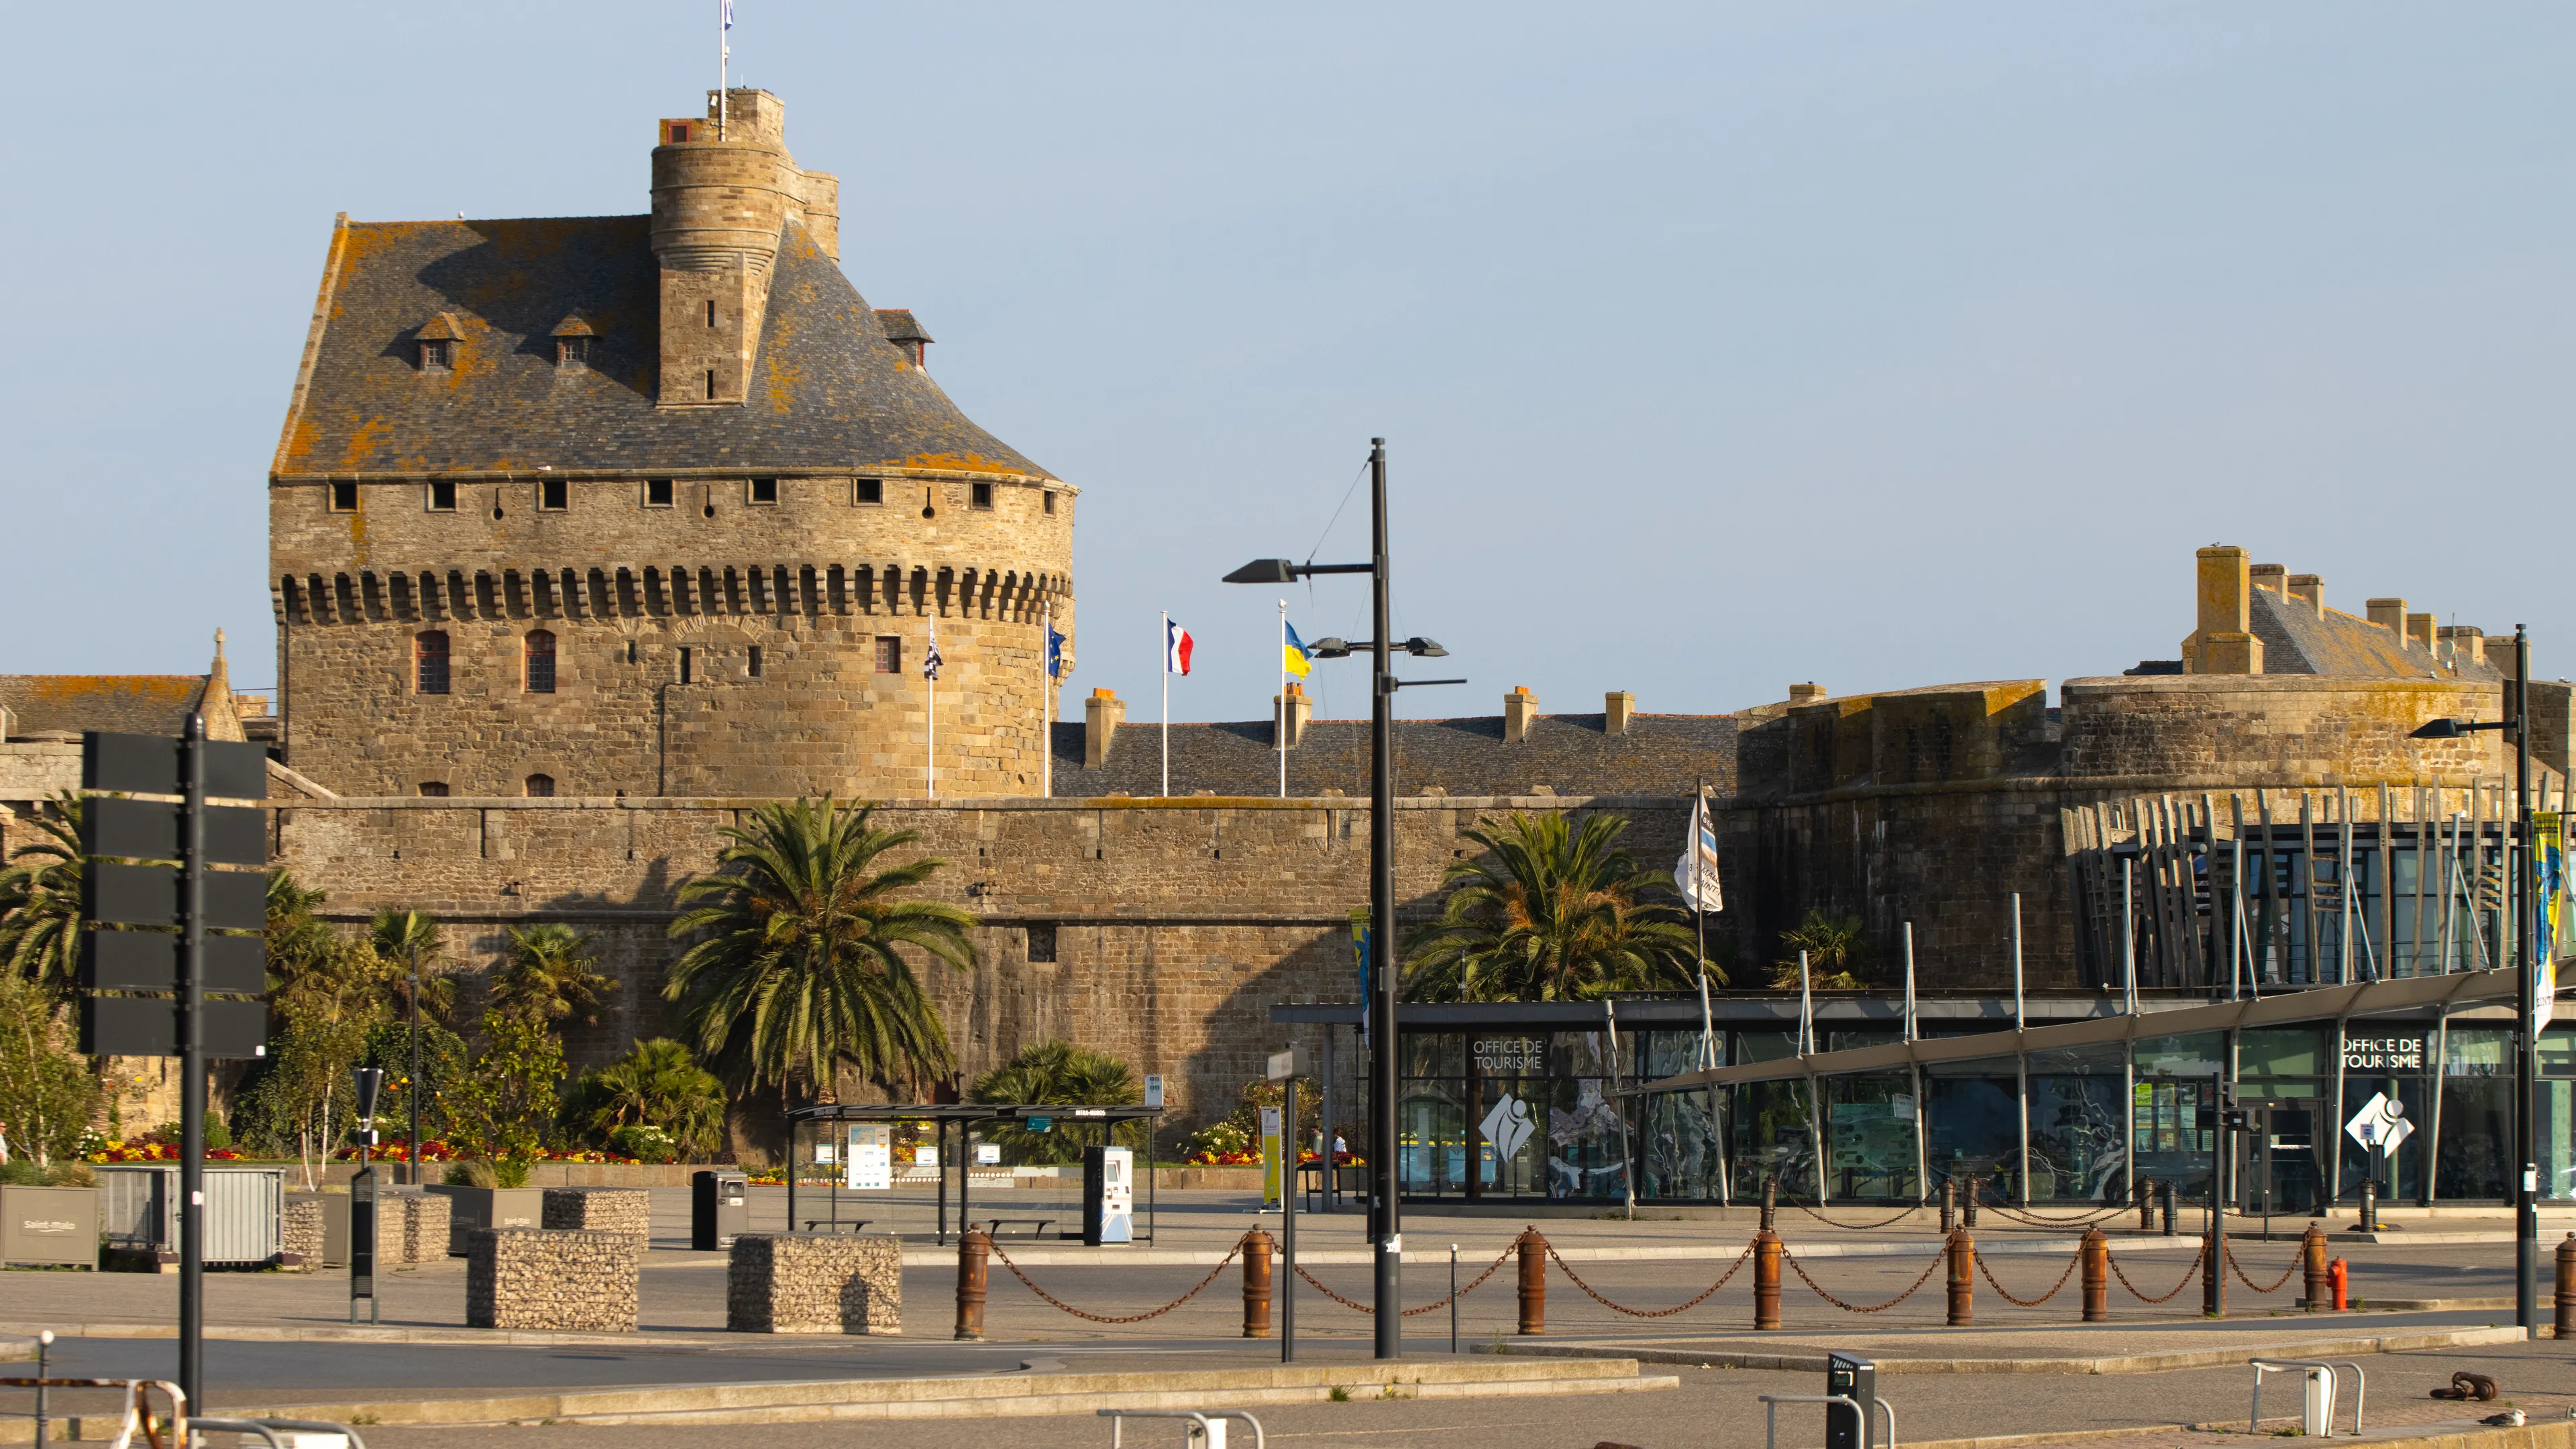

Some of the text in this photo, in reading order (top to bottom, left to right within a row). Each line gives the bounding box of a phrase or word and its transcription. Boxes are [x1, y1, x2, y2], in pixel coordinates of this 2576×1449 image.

[1473, 1040, 1542, 1054] OFFICE DE
[2343, 1038, 2422, 1053] OFFICE DE
[1474, 1056, 1542, 1069] TOURISME
[2342, 1055, 2421, 1069] TOURISME
